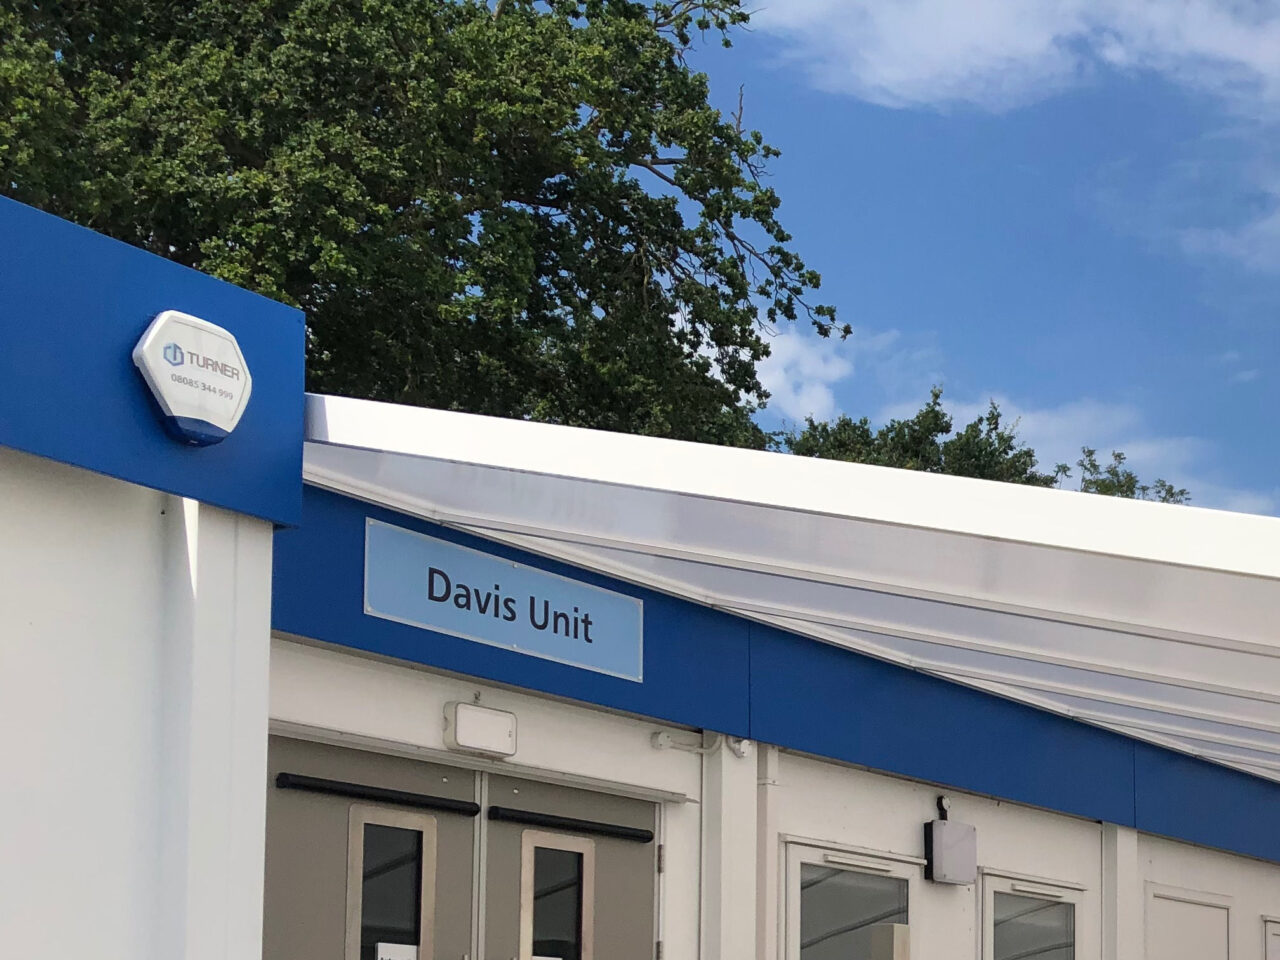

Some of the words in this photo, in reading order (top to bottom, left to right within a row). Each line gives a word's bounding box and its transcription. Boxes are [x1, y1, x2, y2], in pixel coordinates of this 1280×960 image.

[187, 351, 240, 381] TURNER
[427, 566, 517, 622] Davis
[529, 596, 593, 644] Unit
